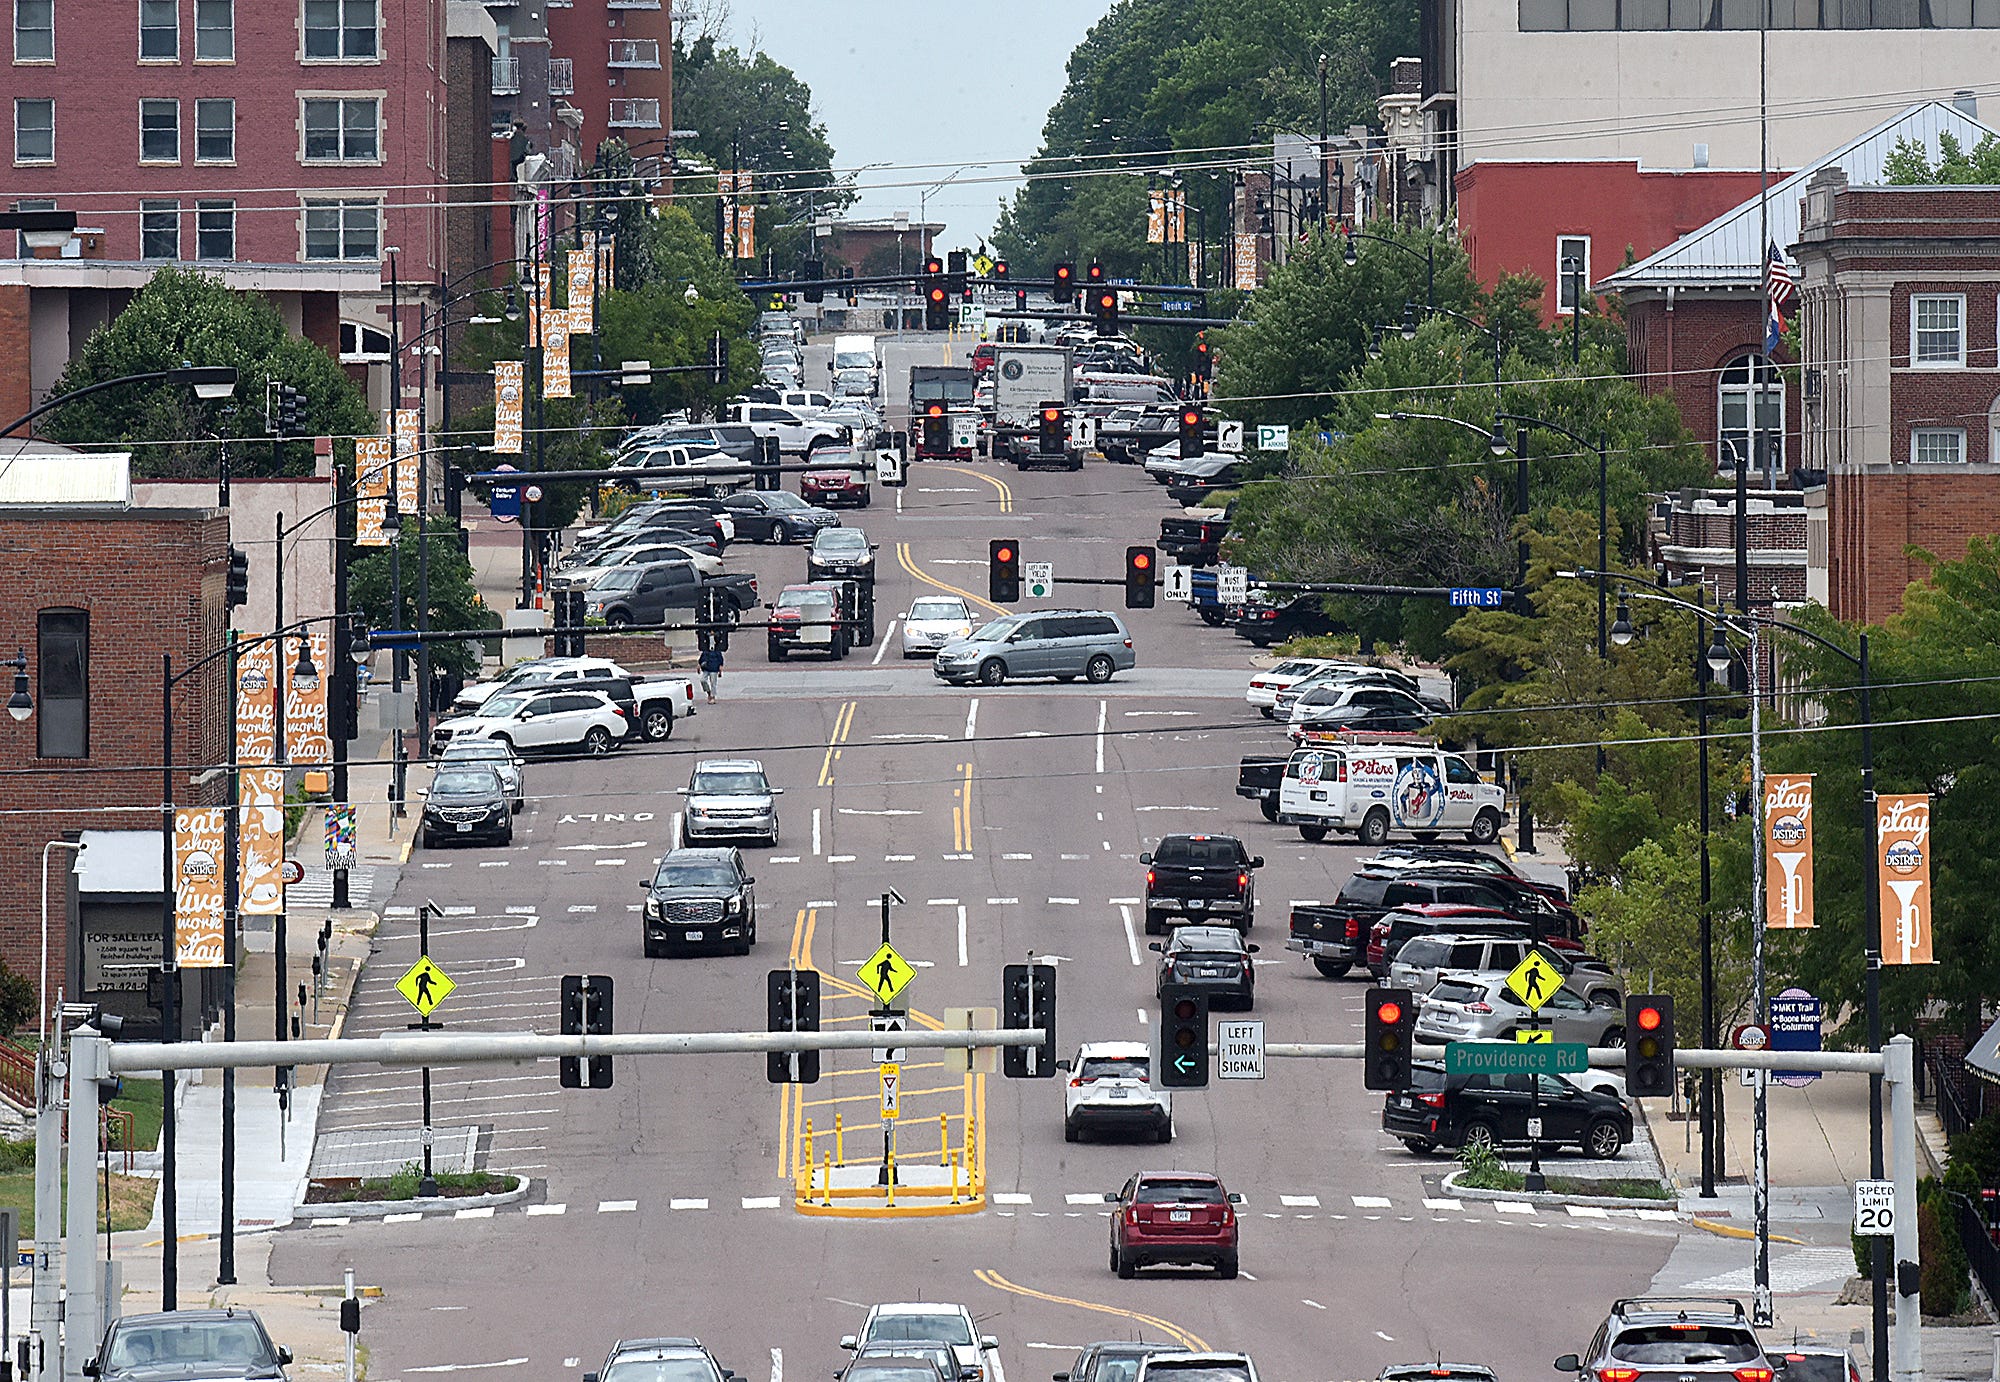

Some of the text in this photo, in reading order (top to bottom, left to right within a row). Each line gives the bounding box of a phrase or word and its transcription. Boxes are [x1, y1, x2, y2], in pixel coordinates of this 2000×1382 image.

[568, 250, 594, 264] eat
[569, 286, 592, 305] live
[1164, 301, 1191, 311] Tenth St
[541, 310, 569, 325] eat
[569, 314, 592, 333] play
[542, 324, 569, 336] shop
[543, 348, 570, 367] live
[495, 362, 522, 377] eat
[543, 366, 569, 377] work
[495, 376, 521, 389] shop
[543, 377, 571, 396] play
[495, 401, 522, 421] live
[496, 418, 521, 431] work
[356, 438, 389, 455] eat
[495, 431, 522, 450] play
[1224, 577, 1240, 585] MUST
[1453, 590, 1498, 605] Fifth St
[286, 633, 327, 656] et
[238, 653, 272, 676] shop
[237, 690, 274, 720] live
[286, 690, 326, 720] live
[237, 716, 272, 734] work
[287, 715, 324, 734] work
[236, 734, 274, 766] play
[286, 733, 328, 766] play
[1351, 759, 1394, 776] Peters
[1449, 789, 1474, 801] Peters
[1764, 778, 1812, 822] play
[175, 808, 225, 834] eat
[558, 812, 655, 824] ONLY
[1877, 799, 1929, 845] play
[1772, 828, 1806, 840] DISTRICT
[176, 831, 224, 856] shop
[1885, 853, 1923, 867] DISTRICT
[181, 863, 218, 876] DISTRICT
[175, 876, 224, 915] live
[177, 912, 223, 930] work
[87, 933, 110, 943] FOR
[175, 930, 225, 967] play
[1778, 1003, 1814, 1012] MKT Trail
[1779, 1014, 1820, 1022] Boone Home
[1228, 1027, 1254, 1038] LEFT
[1781, 1023, 1814, 1032] Columns
[1739, 1036, 1767, 1045] DISTRICT
[1229, 1044, 1256, 1055] TURN
[1457, 1049, 1577, 1067] Providence Rd
[1222, 1061, 1261, 1073] SIGNAL
[1858, 1186, 1894, 1196] SPEED
[1862, 1197, 1890, 1206] LIMIT
[1860, 1208, 1894, 1228] 20
